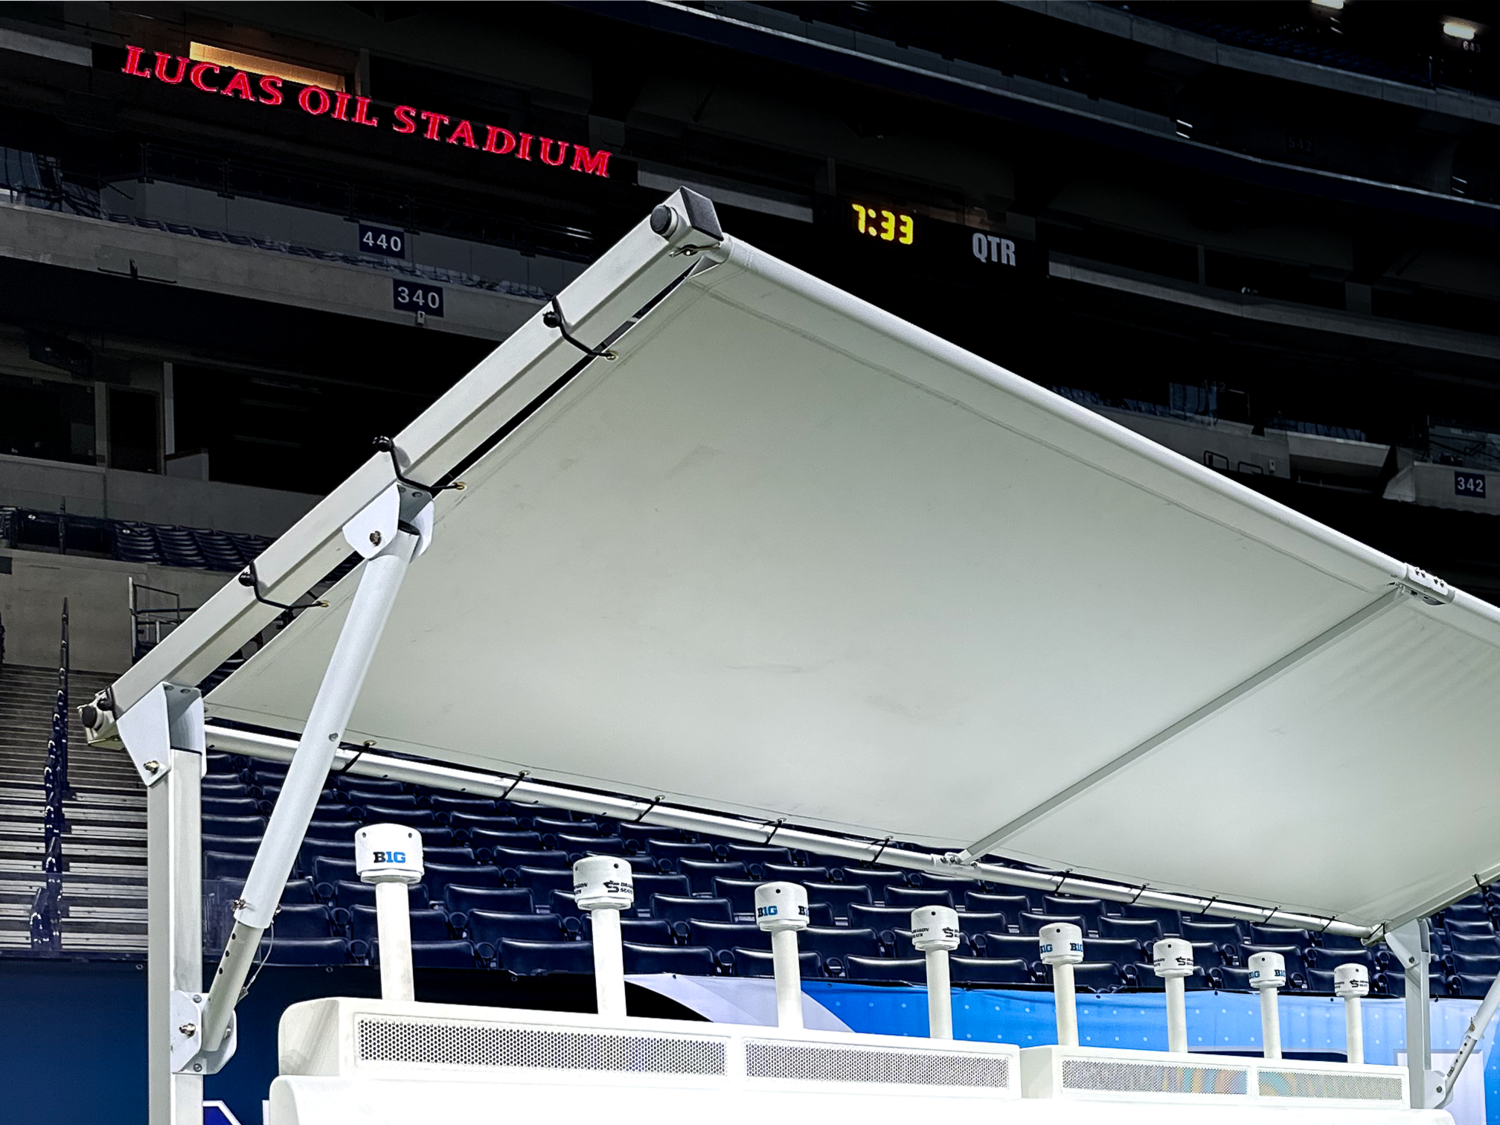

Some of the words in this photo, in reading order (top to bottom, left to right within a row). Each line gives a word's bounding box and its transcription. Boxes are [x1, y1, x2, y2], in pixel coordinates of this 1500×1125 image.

[121, 44, 284, 105] LUCAS
[298, 84, 378, 127] OIL
[392, 105, 613, 178] STADIUM
[852, 203, 914, 245] 7:33
[362, 231, 402, 252] 440
[972, 232, 1016, 267] QTR
[397, 286, 440, 309] 340
[1456, 476, 1485, 494] 342
